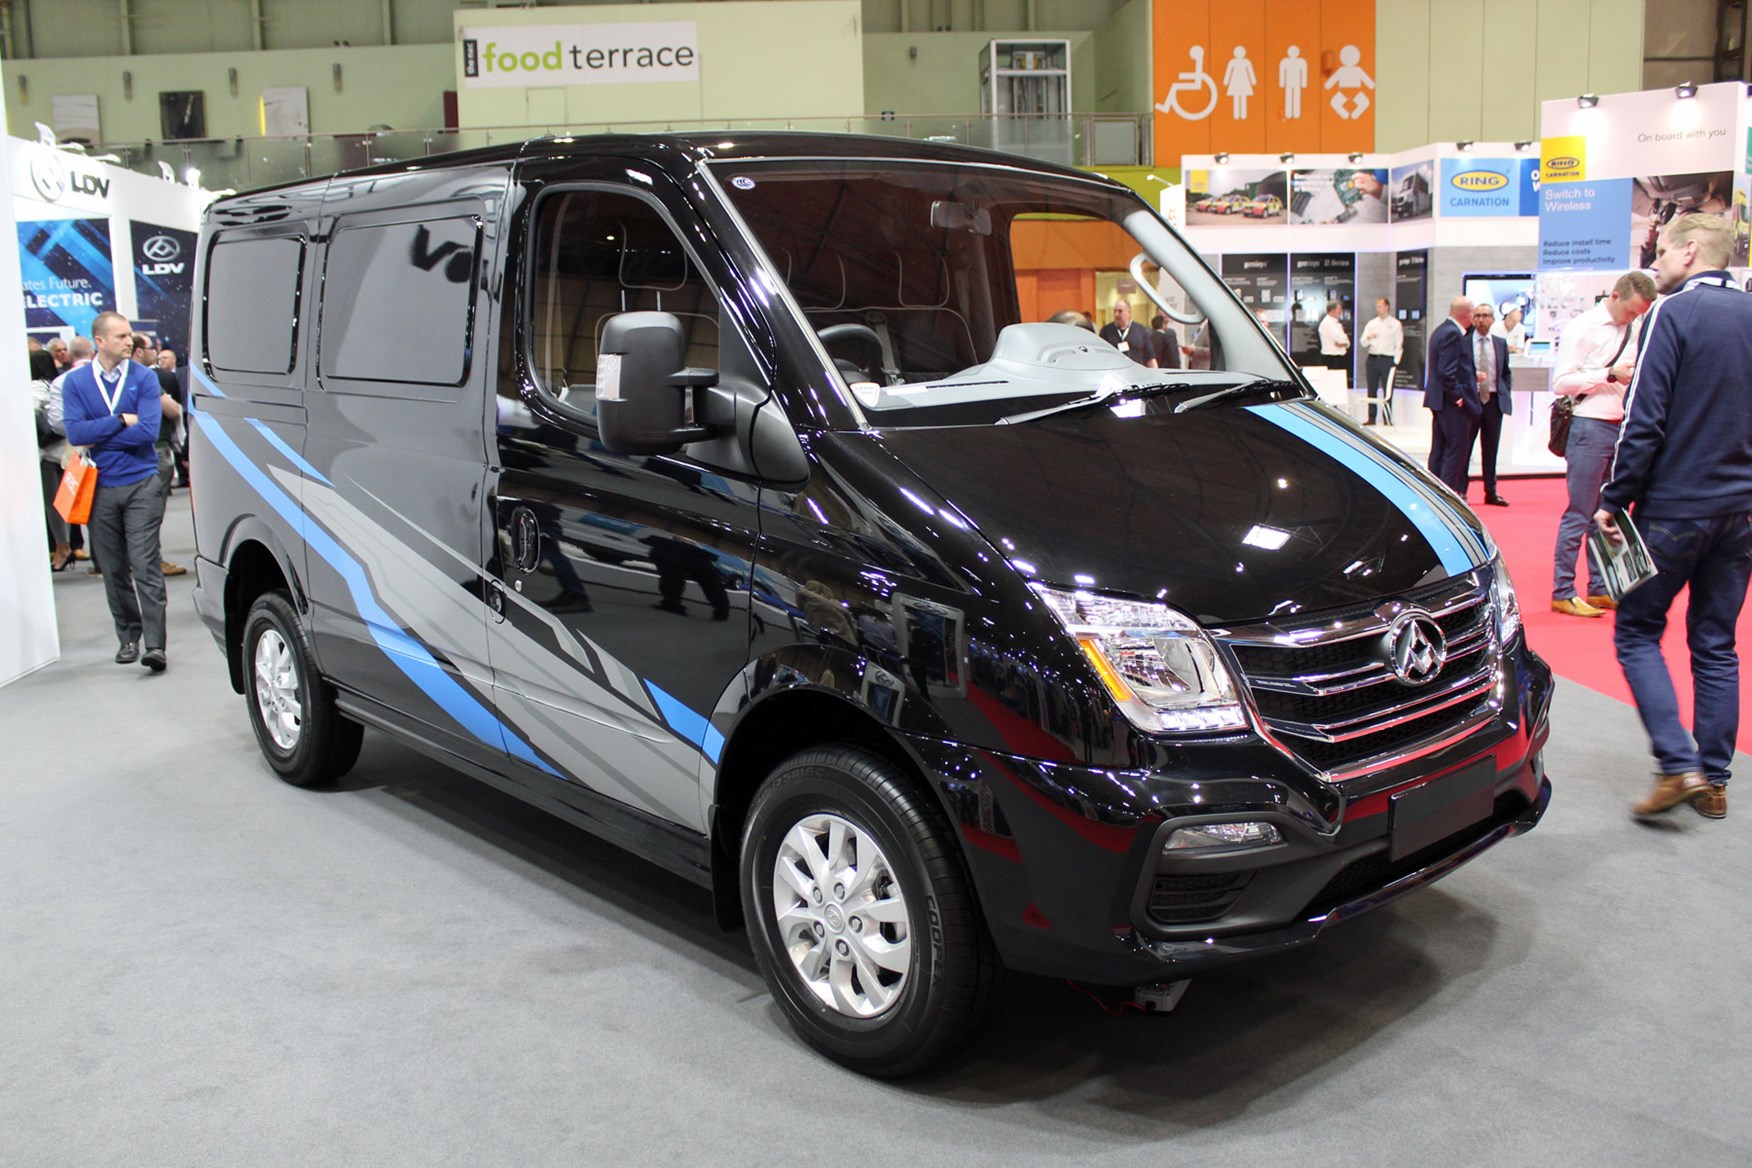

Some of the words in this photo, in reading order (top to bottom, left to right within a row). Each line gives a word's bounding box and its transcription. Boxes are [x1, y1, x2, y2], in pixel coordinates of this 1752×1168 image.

[482, 40, 562, 72] food
[569, 45, 694, 69] terrace
[1637, 133, 1652, 142] On
[1655, 131, 1683, 142] board
[1686, 129, 1706, 139] with
[1709, 128, 1726, 139] you
[70, 170, 110, 199] LDV
[1460, 176, 1500, 186] RING
[1545, 188, 1581, 200] Switch
[1584, 188, 1596, 198] to
[1449, 197, 1510, 207] CARNATION
[1545, 201, 1592, 212] Wireless
[1573, 256, 1615, 265] productivity
[142, 262, 185, 275] LDV
[48, 276, 92, 289] Future.
